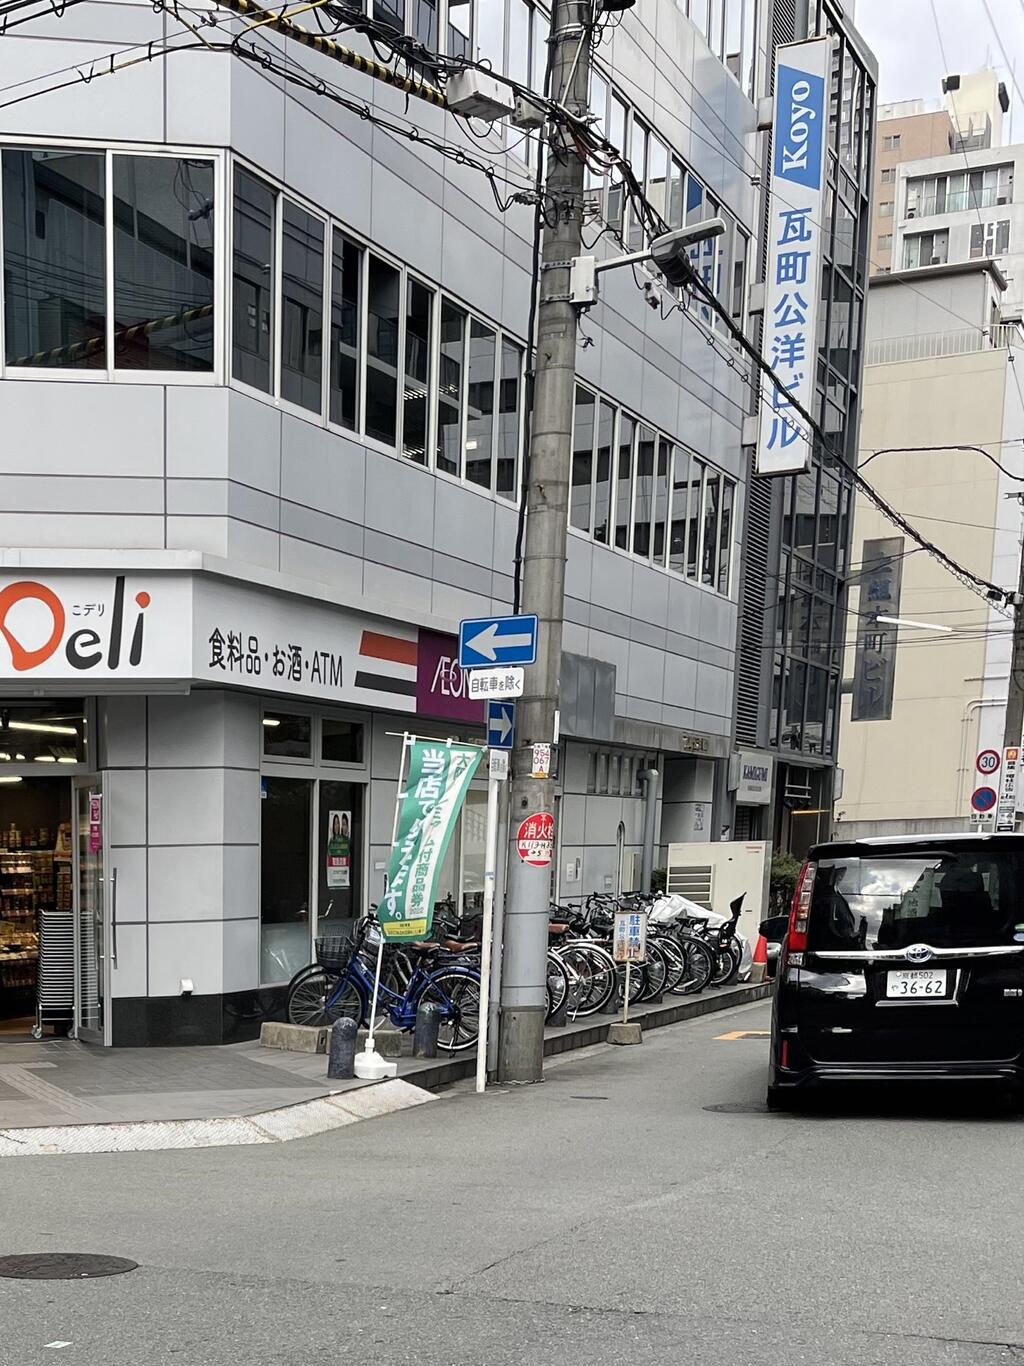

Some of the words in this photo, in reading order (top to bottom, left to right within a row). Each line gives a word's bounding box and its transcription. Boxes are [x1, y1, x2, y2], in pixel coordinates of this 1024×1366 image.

[782, 80, 816, 173] Koyo
[767, 207, 813, 450] 瓦町公洋ビル
[208, 627, 344, 688] 食料品・お酒・ATM
[471, 675, 521, 693] 自転車を除く
[981, 756, 996, 769] 30
[919, 971, 934, 979] 502
[900, 980, 943, 995] 36-62
